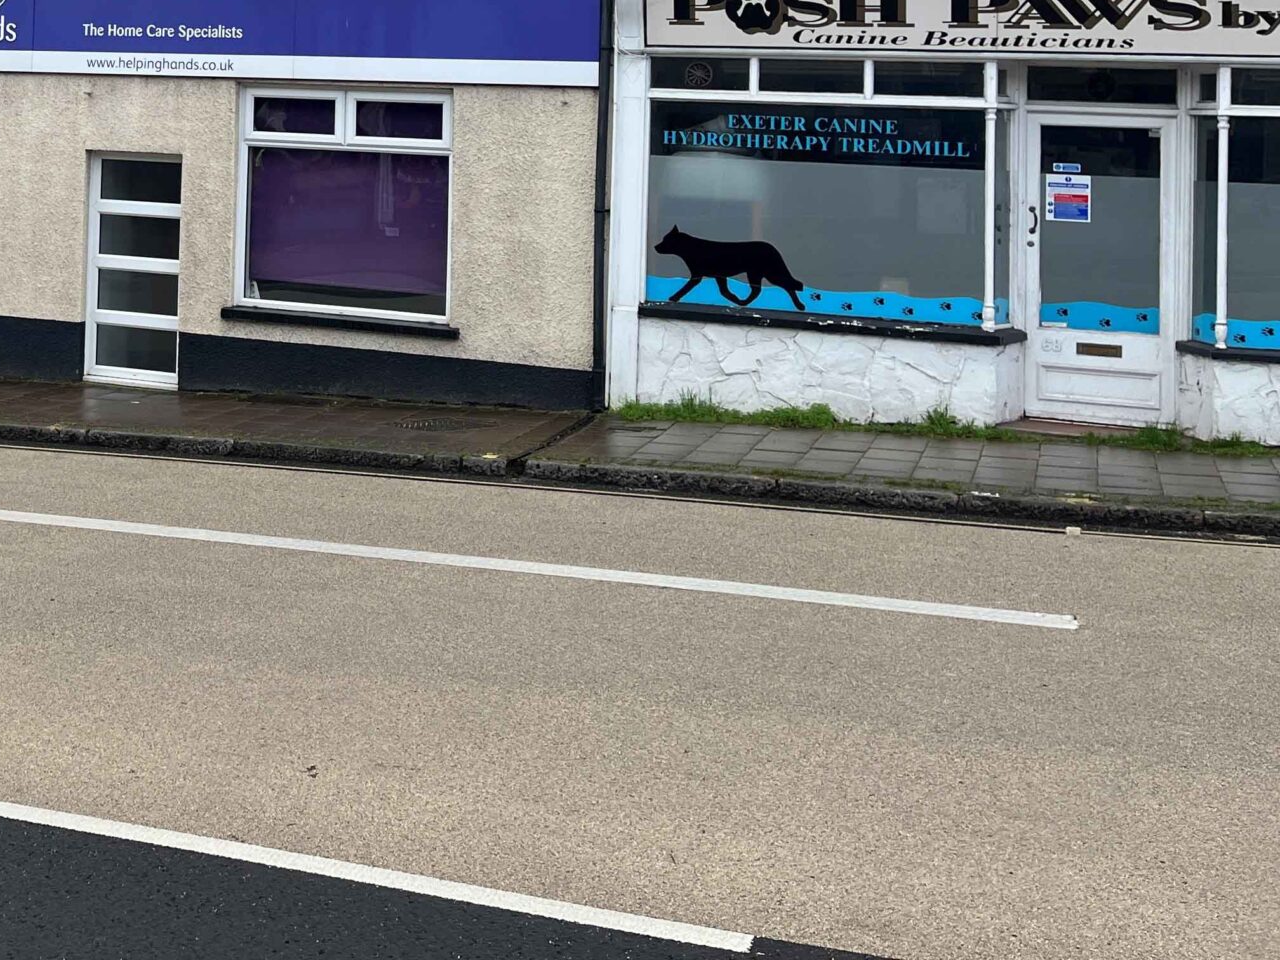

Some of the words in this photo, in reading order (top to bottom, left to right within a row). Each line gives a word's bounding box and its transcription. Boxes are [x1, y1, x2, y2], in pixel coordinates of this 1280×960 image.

[1218, 1, 1280, 35] by
[83, 23, 105, 37] The
[107, 24, 143, 37] Home
[146, 24, 175, 38] Care
[178, 25, 243, 41] Specialists
[792, 28, 908, 45] Canine
[921, 30, 1135, 49] Beauticians
[86, 56, 235, 73] www.helpinghands.co.uk
[727, 114, 807, 132] EXETER
[814, 117, 899, 135] CANINE
[663, 130, 832, 152] HYDROTHERAPY
[838, 137, 970, 157] TREADMILL
